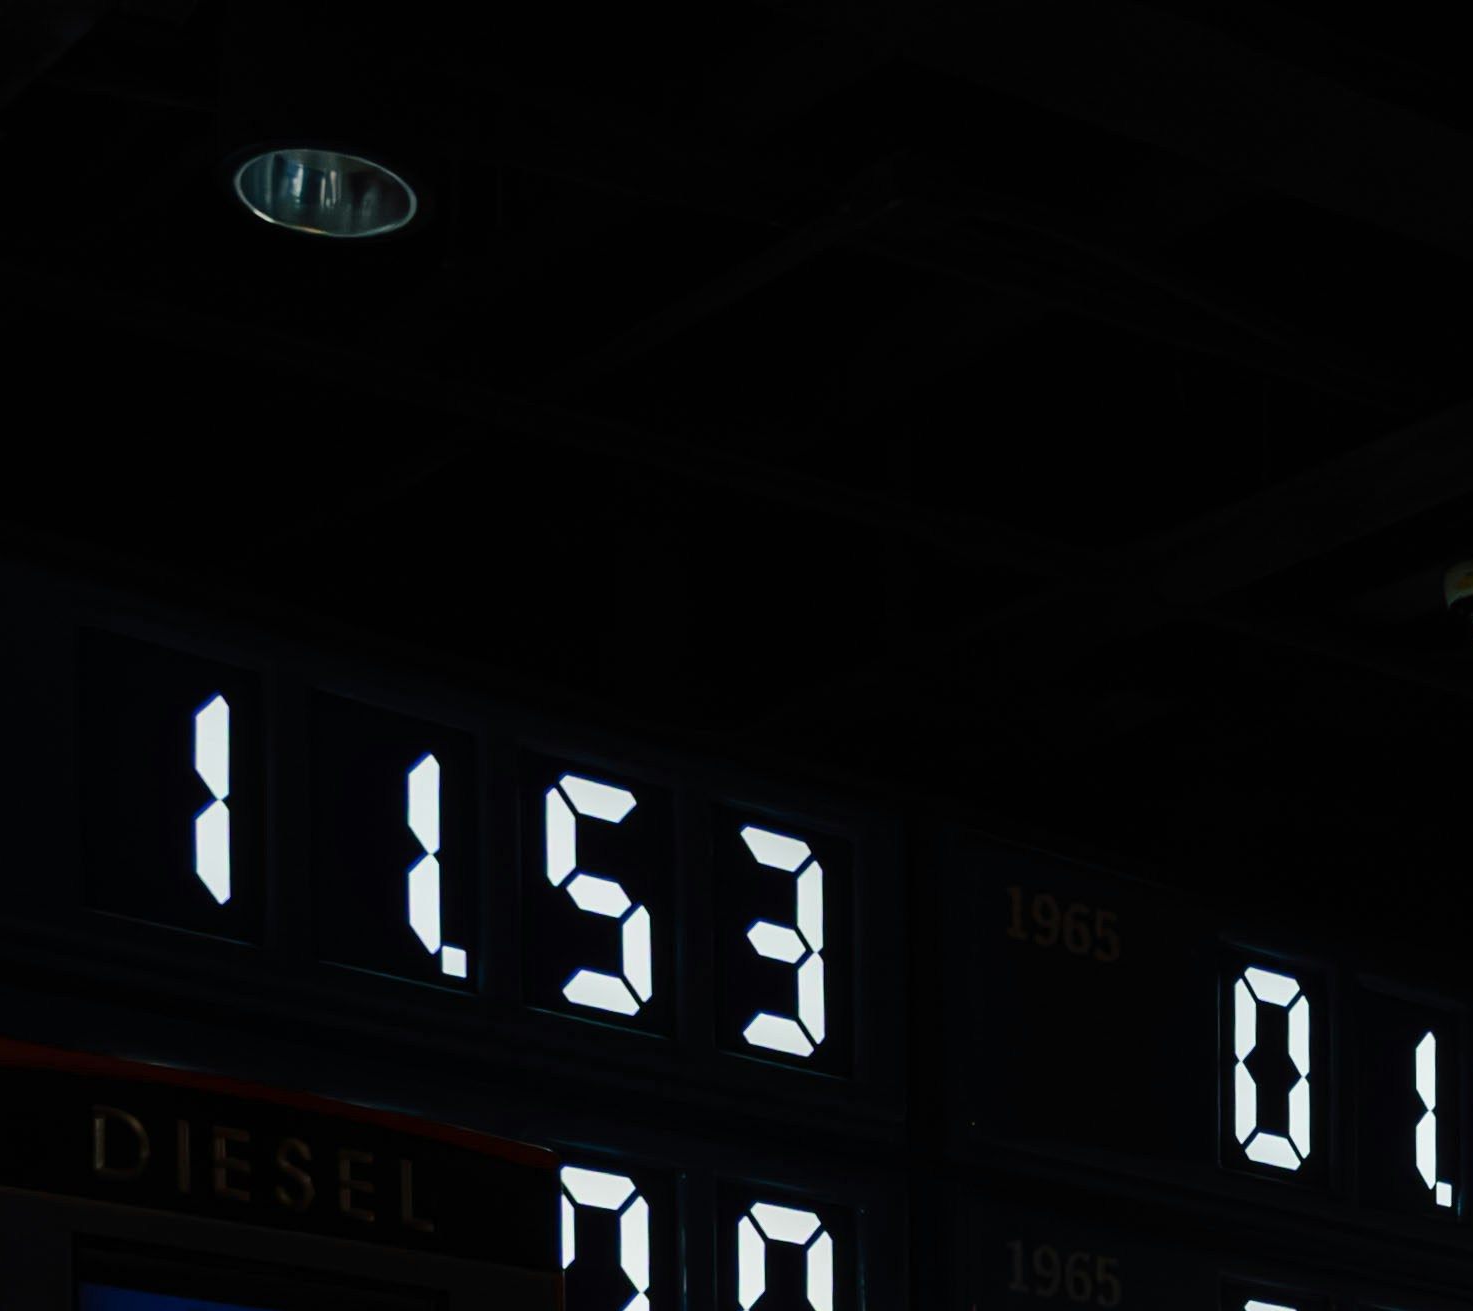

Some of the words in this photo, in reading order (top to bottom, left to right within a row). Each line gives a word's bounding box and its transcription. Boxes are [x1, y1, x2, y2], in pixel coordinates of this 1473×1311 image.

[1005, 885, 1122, 964] 1965
[91, 1103, 439, 1233] DIESEL
[1005, 1239, 1123, 1309] 1965
